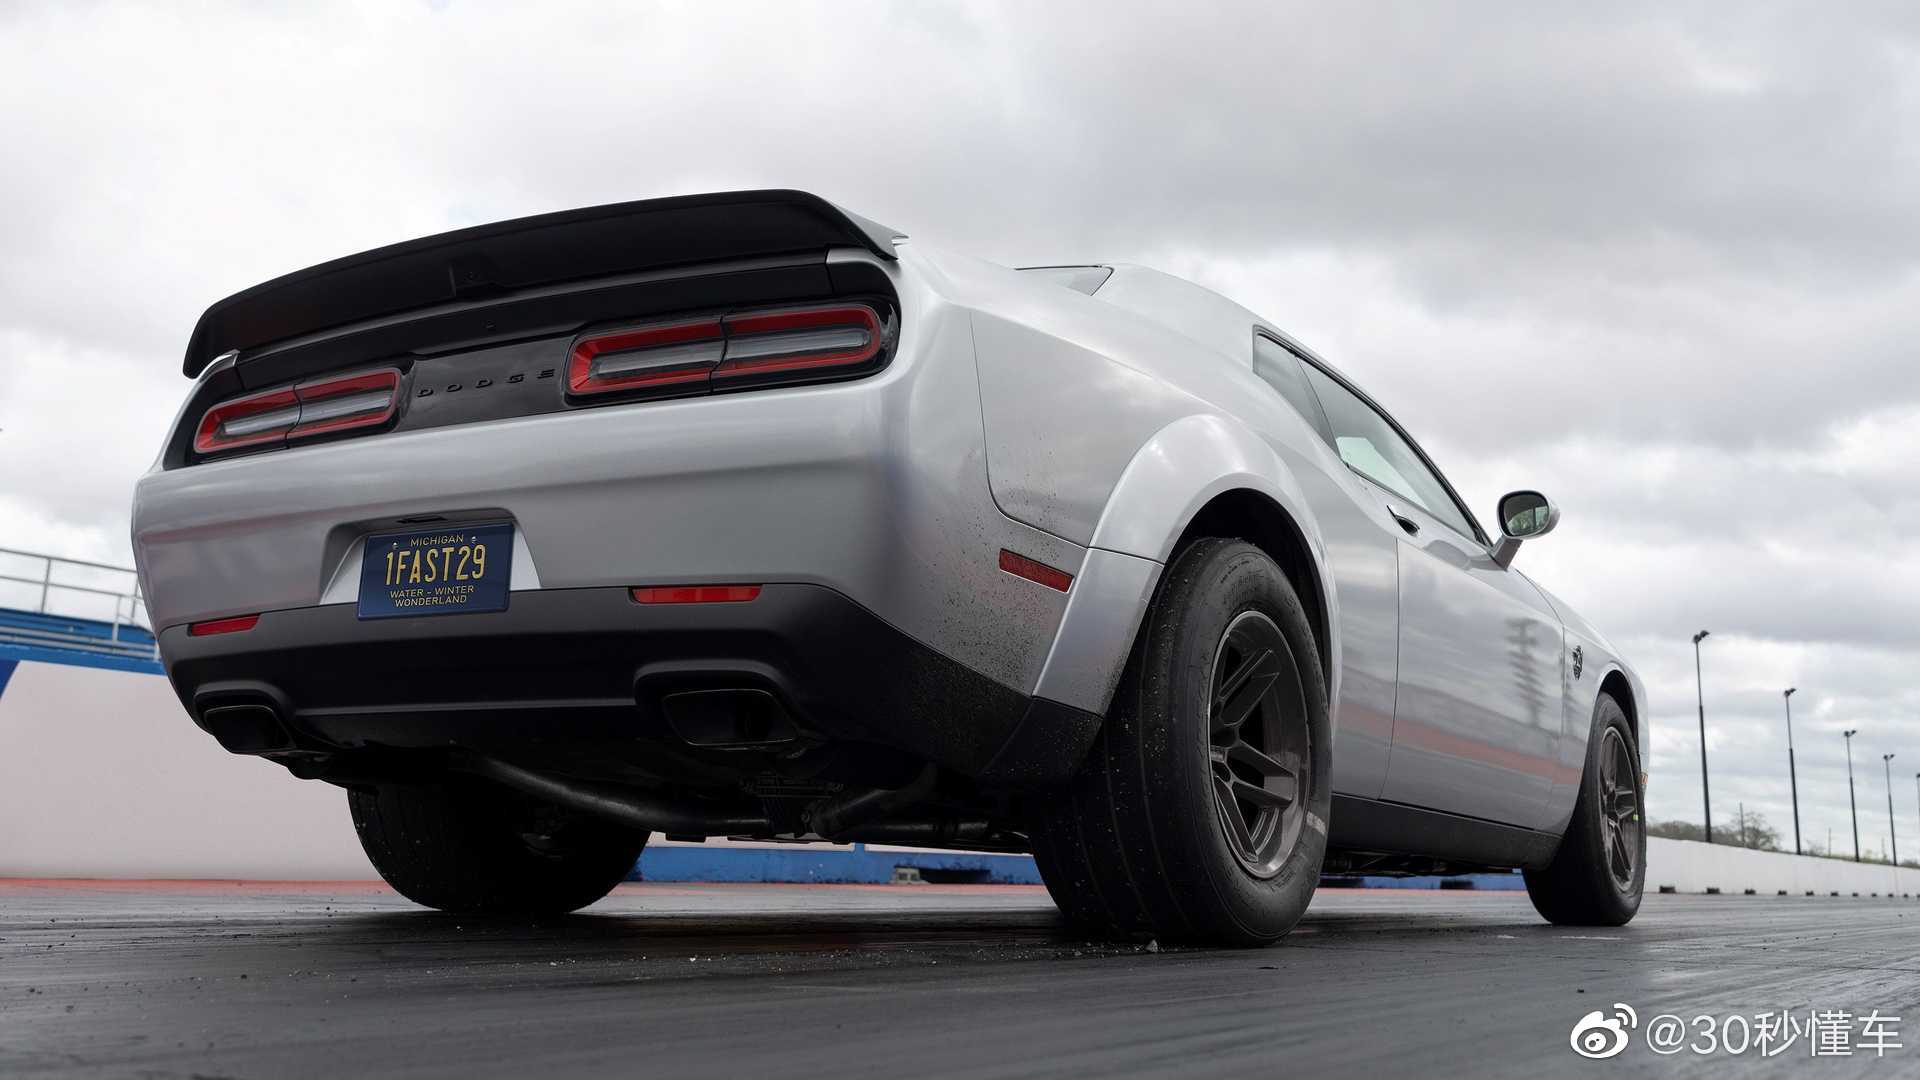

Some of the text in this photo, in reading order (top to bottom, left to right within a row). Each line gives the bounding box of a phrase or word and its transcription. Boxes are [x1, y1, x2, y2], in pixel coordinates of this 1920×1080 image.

[417, 368, 555, 398] DODGE
[410, 534, 464, 546] MICHIGAN
[385, 544, 486, 586] 1FAST29
[389, 589, 424, 599] WATER
[435, 585, 475, 596] WINTER
[395, 595, 467, 607] WONDERLAND
